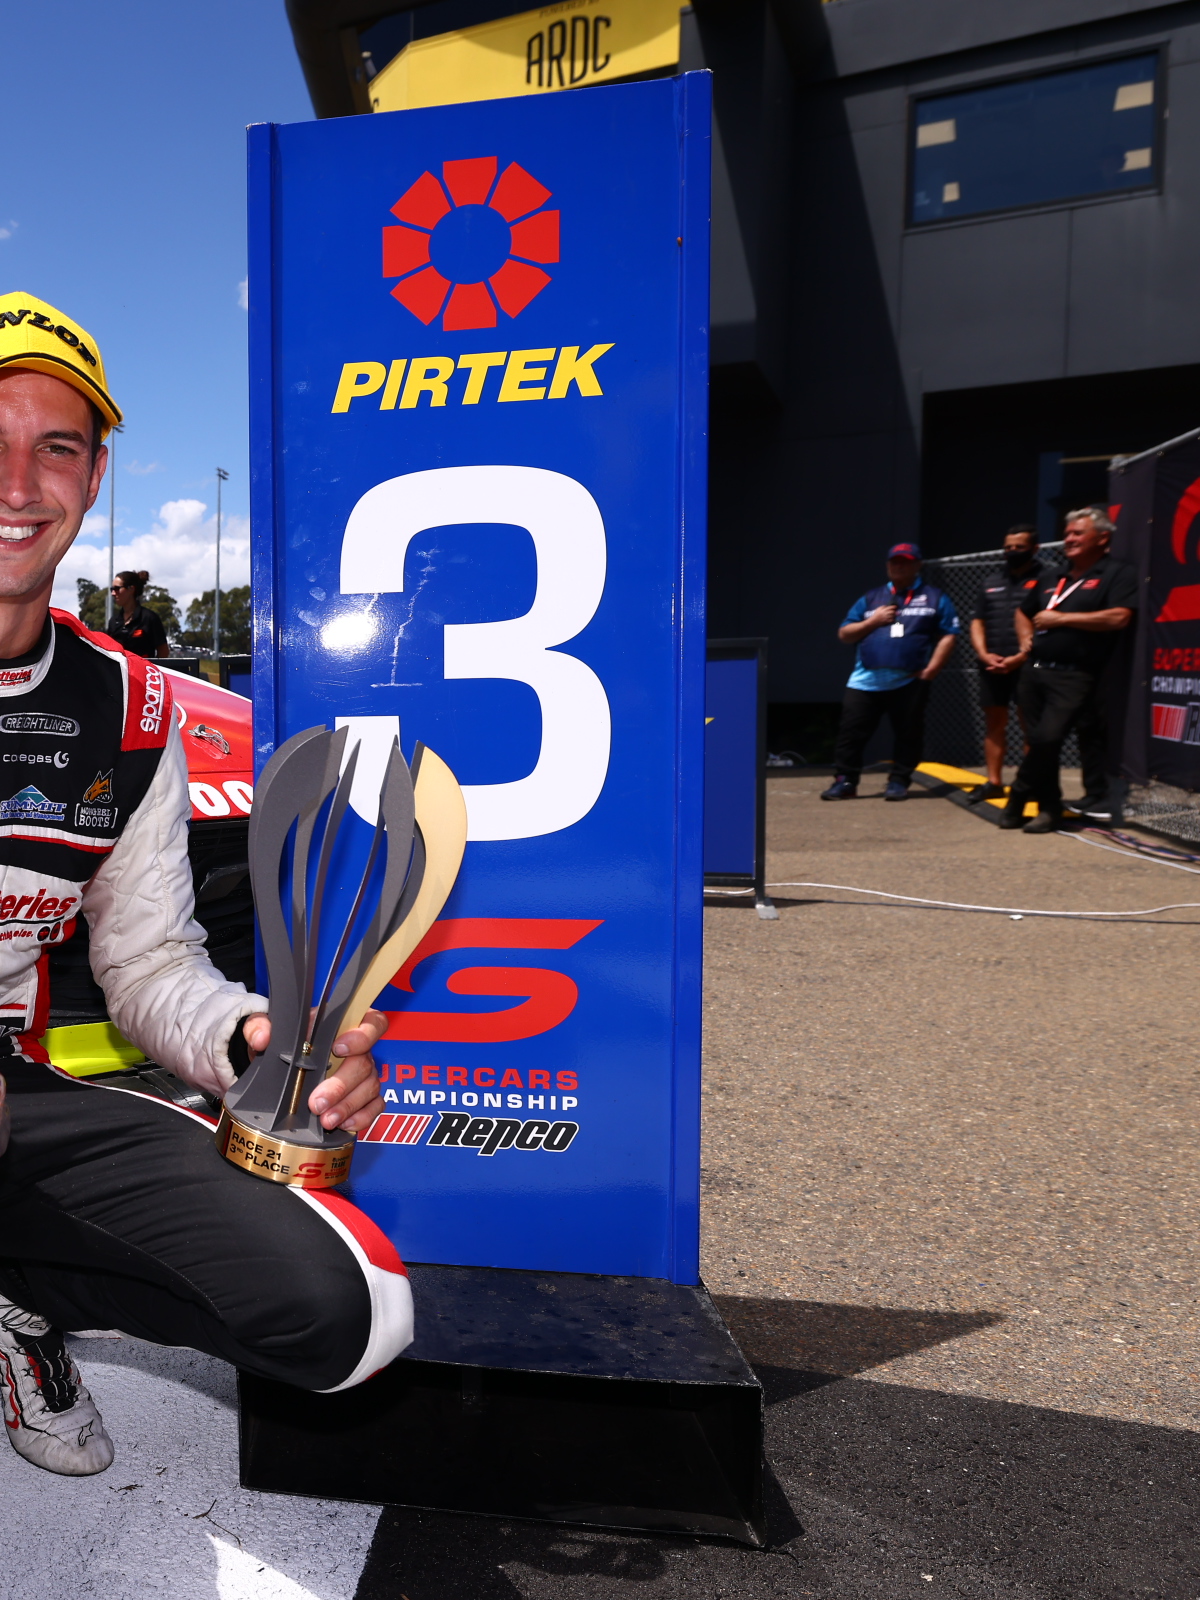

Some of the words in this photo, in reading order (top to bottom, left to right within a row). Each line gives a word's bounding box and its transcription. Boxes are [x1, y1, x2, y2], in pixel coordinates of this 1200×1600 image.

[526, 14, 611, 88] ARDC
[331, 343, 615, 413] PIRTEK
[335, 465, 611, 841] 3
[140, 665, 166, 735] sparco
[5, 716, 73, 733] FREIGHTLINER
[0, 800, 68, 813] SUMMIT
[79, 815, 110, 827] BOOTS
[380, 1064, 579, 1090] UPERCARS
[231, 1131, 263, 1155] RACE
[266, 1148, 282, 1161] 21
[426, 1110, 579, 1157] Repco
[245, 1152, 290, 1176] PLACE
